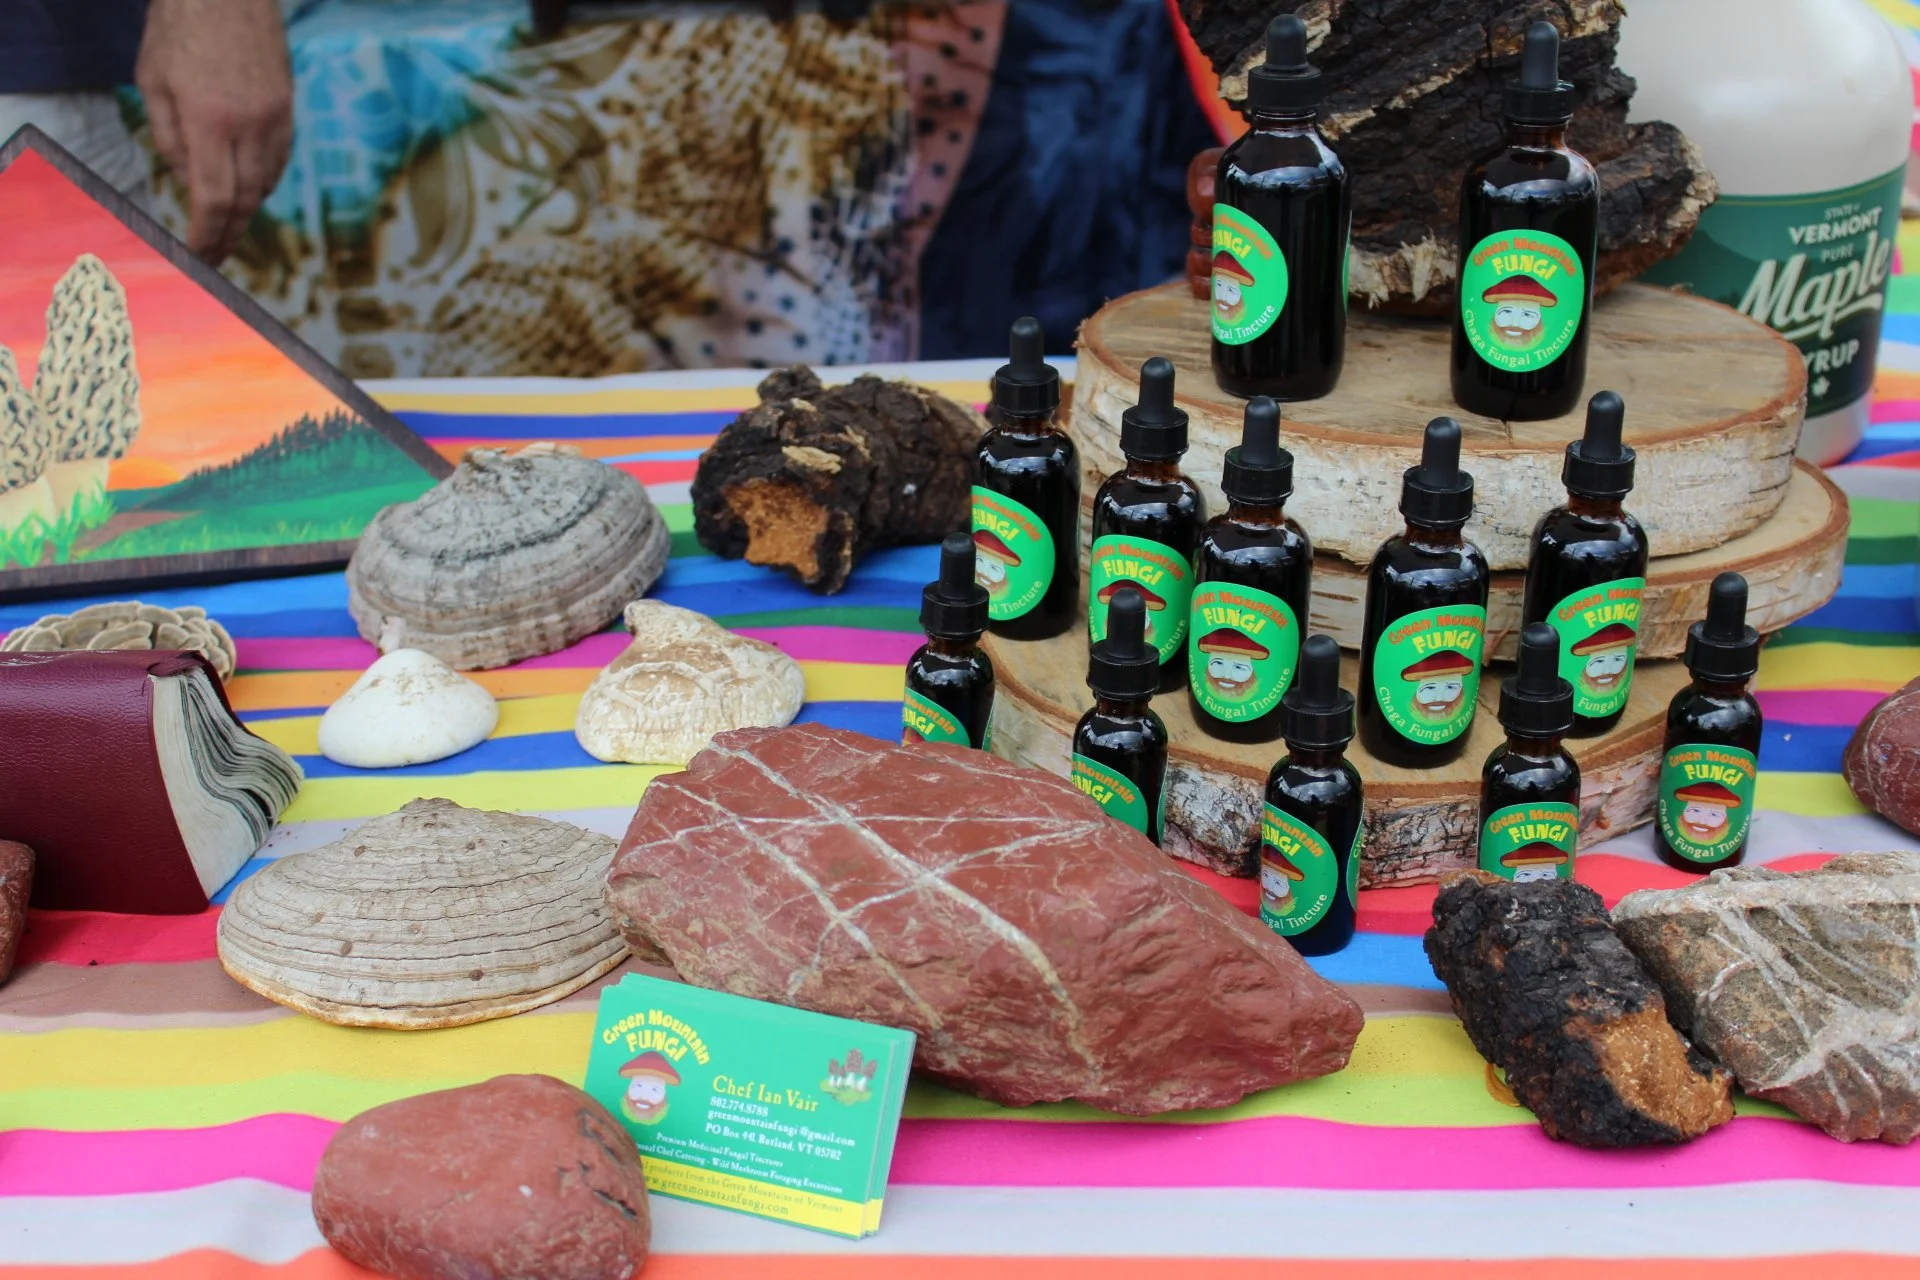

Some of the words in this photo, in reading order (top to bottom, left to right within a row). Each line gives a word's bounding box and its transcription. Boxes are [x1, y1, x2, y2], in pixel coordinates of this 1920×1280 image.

[1788, 206, 1882, 246] VERMONT
[1473, 240, 1509, 267] Green
[1513, 236, 1577, 276] Mountain
[1492, 254, 1558, 280] FUNGI
[1820, 243, 1854, 263] PURE
[1738, 229, 1890, 340] Maple
[1234, 305, 1275, 339] Tincture
[1465, 309, 1486, 349] Chaga
[1487, 346, 1531, 368] Fungal
[1533, 319, 1575, 361] Tincture
[1804, 338, 1860, 375] YRUP
[1102, 559, 1164, 586] FUNGI
[1001, 580, 1043, 614] Tincture
[1219, 590, 1288, 630] Mountain
[1558, 593, 1604, 623] Green
[1203, 607, 1266, 634] FUNGI
[1388, 618, 1432, 645] Green
[1584, 602, 1640, 628] FUNGI
[1159, 619, 1186, 657] ncture
[1412, 630, 1476, 654] FUNGI
[1205, 696, 1246, 719] Fungal
[1249, 667, 1290, 712] Tincture
[1578, 697, 1619, 714] Fungal
[1379, 686, 1406, 728] Chaga
[1409, 723, 1453, 742] Fungal
[1684, 764, 1744, 786] FUNGI
[1263, 824, 1302, 856] UNGI
[1489, 812, 1525, 834] Green
[1508, 823, 1569, 843] FUNGI
[1660, 799, 1674, 838] Chaga
[1675, 837, 1714, 858] Fungal
[1717, 815, 1750, 853] Tincture
[1286, 894, 1327, 929] Tincture
[602, 1012, 645, 1045] Green
[648, 1008, 710, 1065] Mountain
[626, 1029, 688, 1062] FUNGI
[713, 1075, 755, 1099] Chef
[758, 1084, 782, 1105] Ian
[786, 1089, 819, 1112] Vair
[656, 1132, 687, 1146] Premium
[688, 1139, 722, 1153] Medicinal
[724, 1147, 749, 1160] Fungal
[705, 1122, 721, 1135] PO
[723, 1126, 740, 1139] Box
[798, 1142, 814, 1155] VT
[814, 1147, 842, 1161] 05702
[656, 1146, 674, 1157] Chef
[675, 1150, 705, 1165] Catering
[712, 1157, 730, 1169] Wild
[769, 1170, 802, 1187] Foraging
[686, 1171, 705, 1182] from
[708, 1176, 720, 1186] the
[646, 1176, 788, 1215] ww.greenmountainfungi.com
